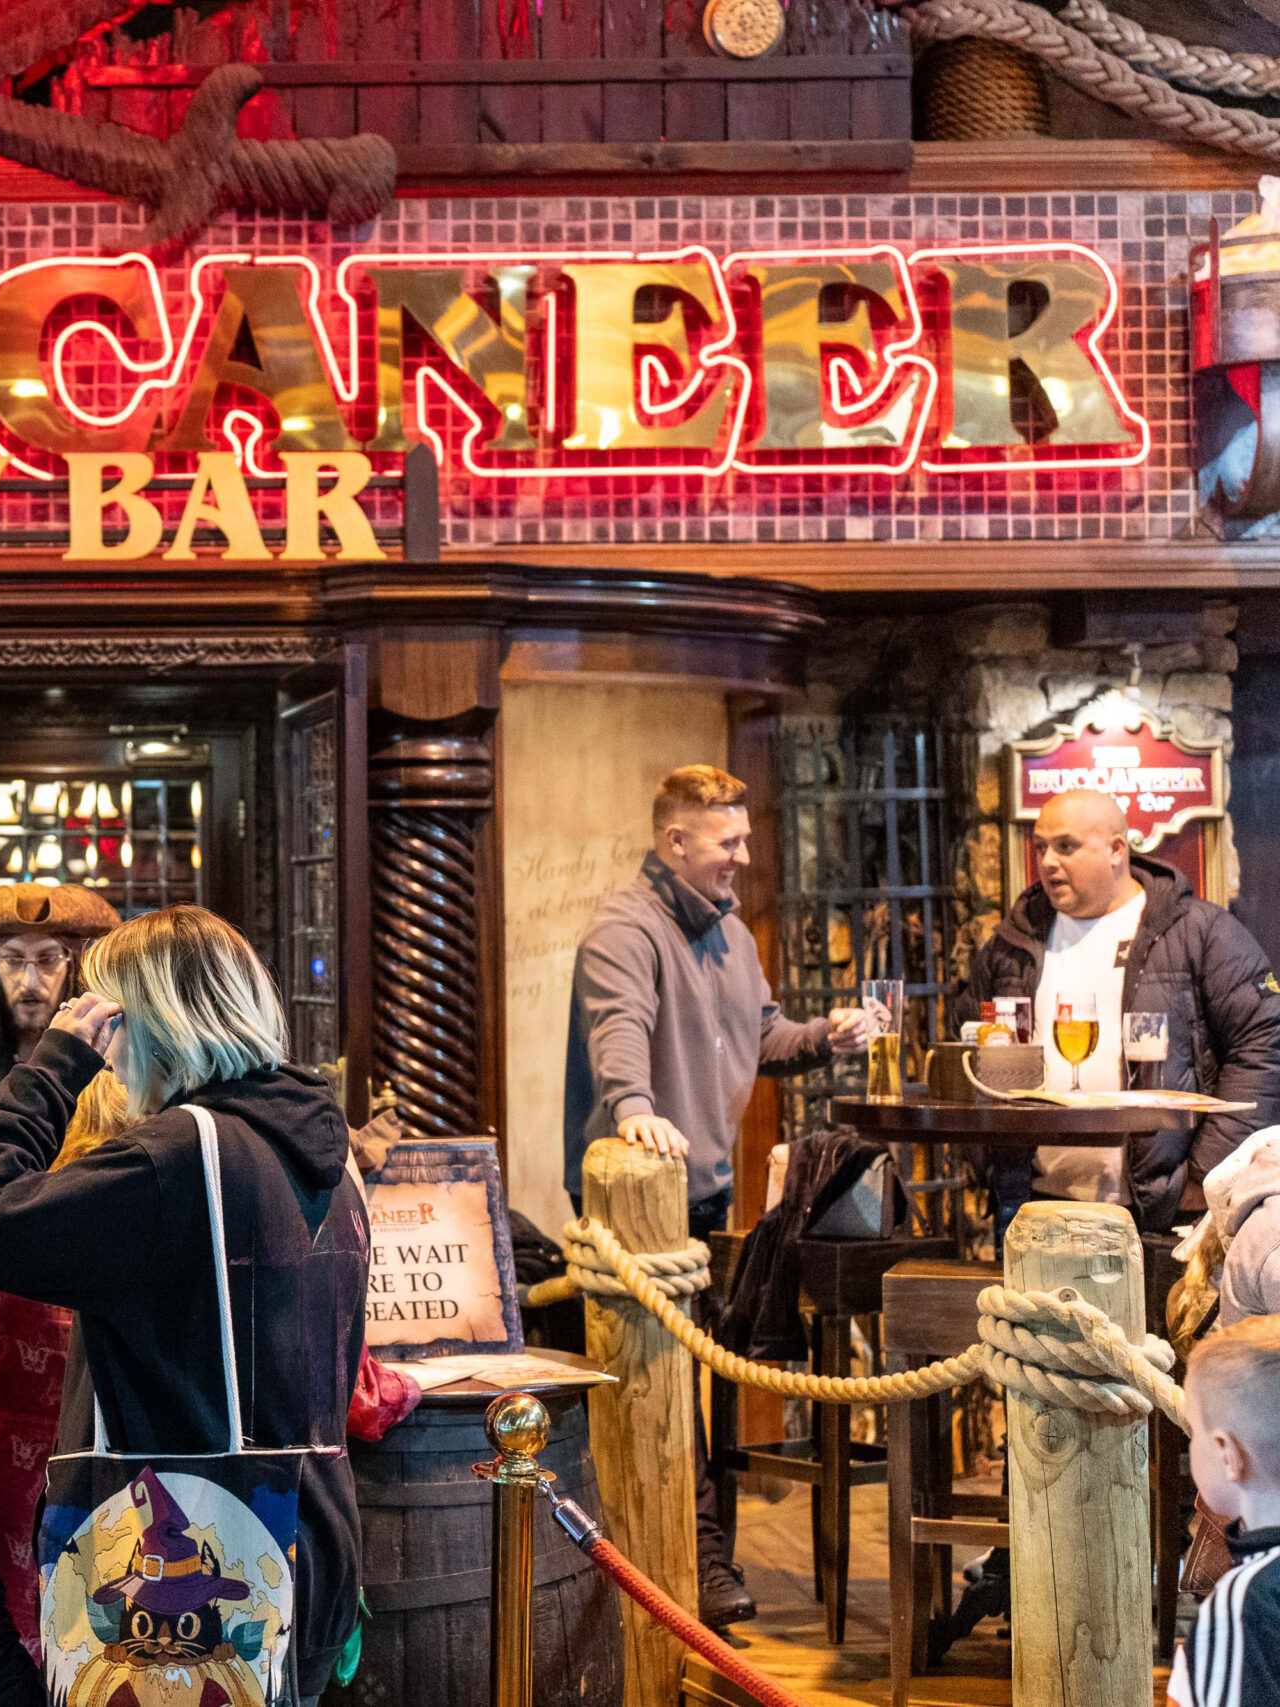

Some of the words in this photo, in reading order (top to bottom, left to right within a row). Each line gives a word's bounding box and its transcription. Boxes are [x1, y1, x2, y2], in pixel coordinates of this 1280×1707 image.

[60, 453, 388, 566] BAR
[370, 1202, 440, 1225] ANEER
[396, 1244, 469, 1264] WAIT
[367, 1273, 396, 1293] RE
[404, 1271, 443, 1292] TO
